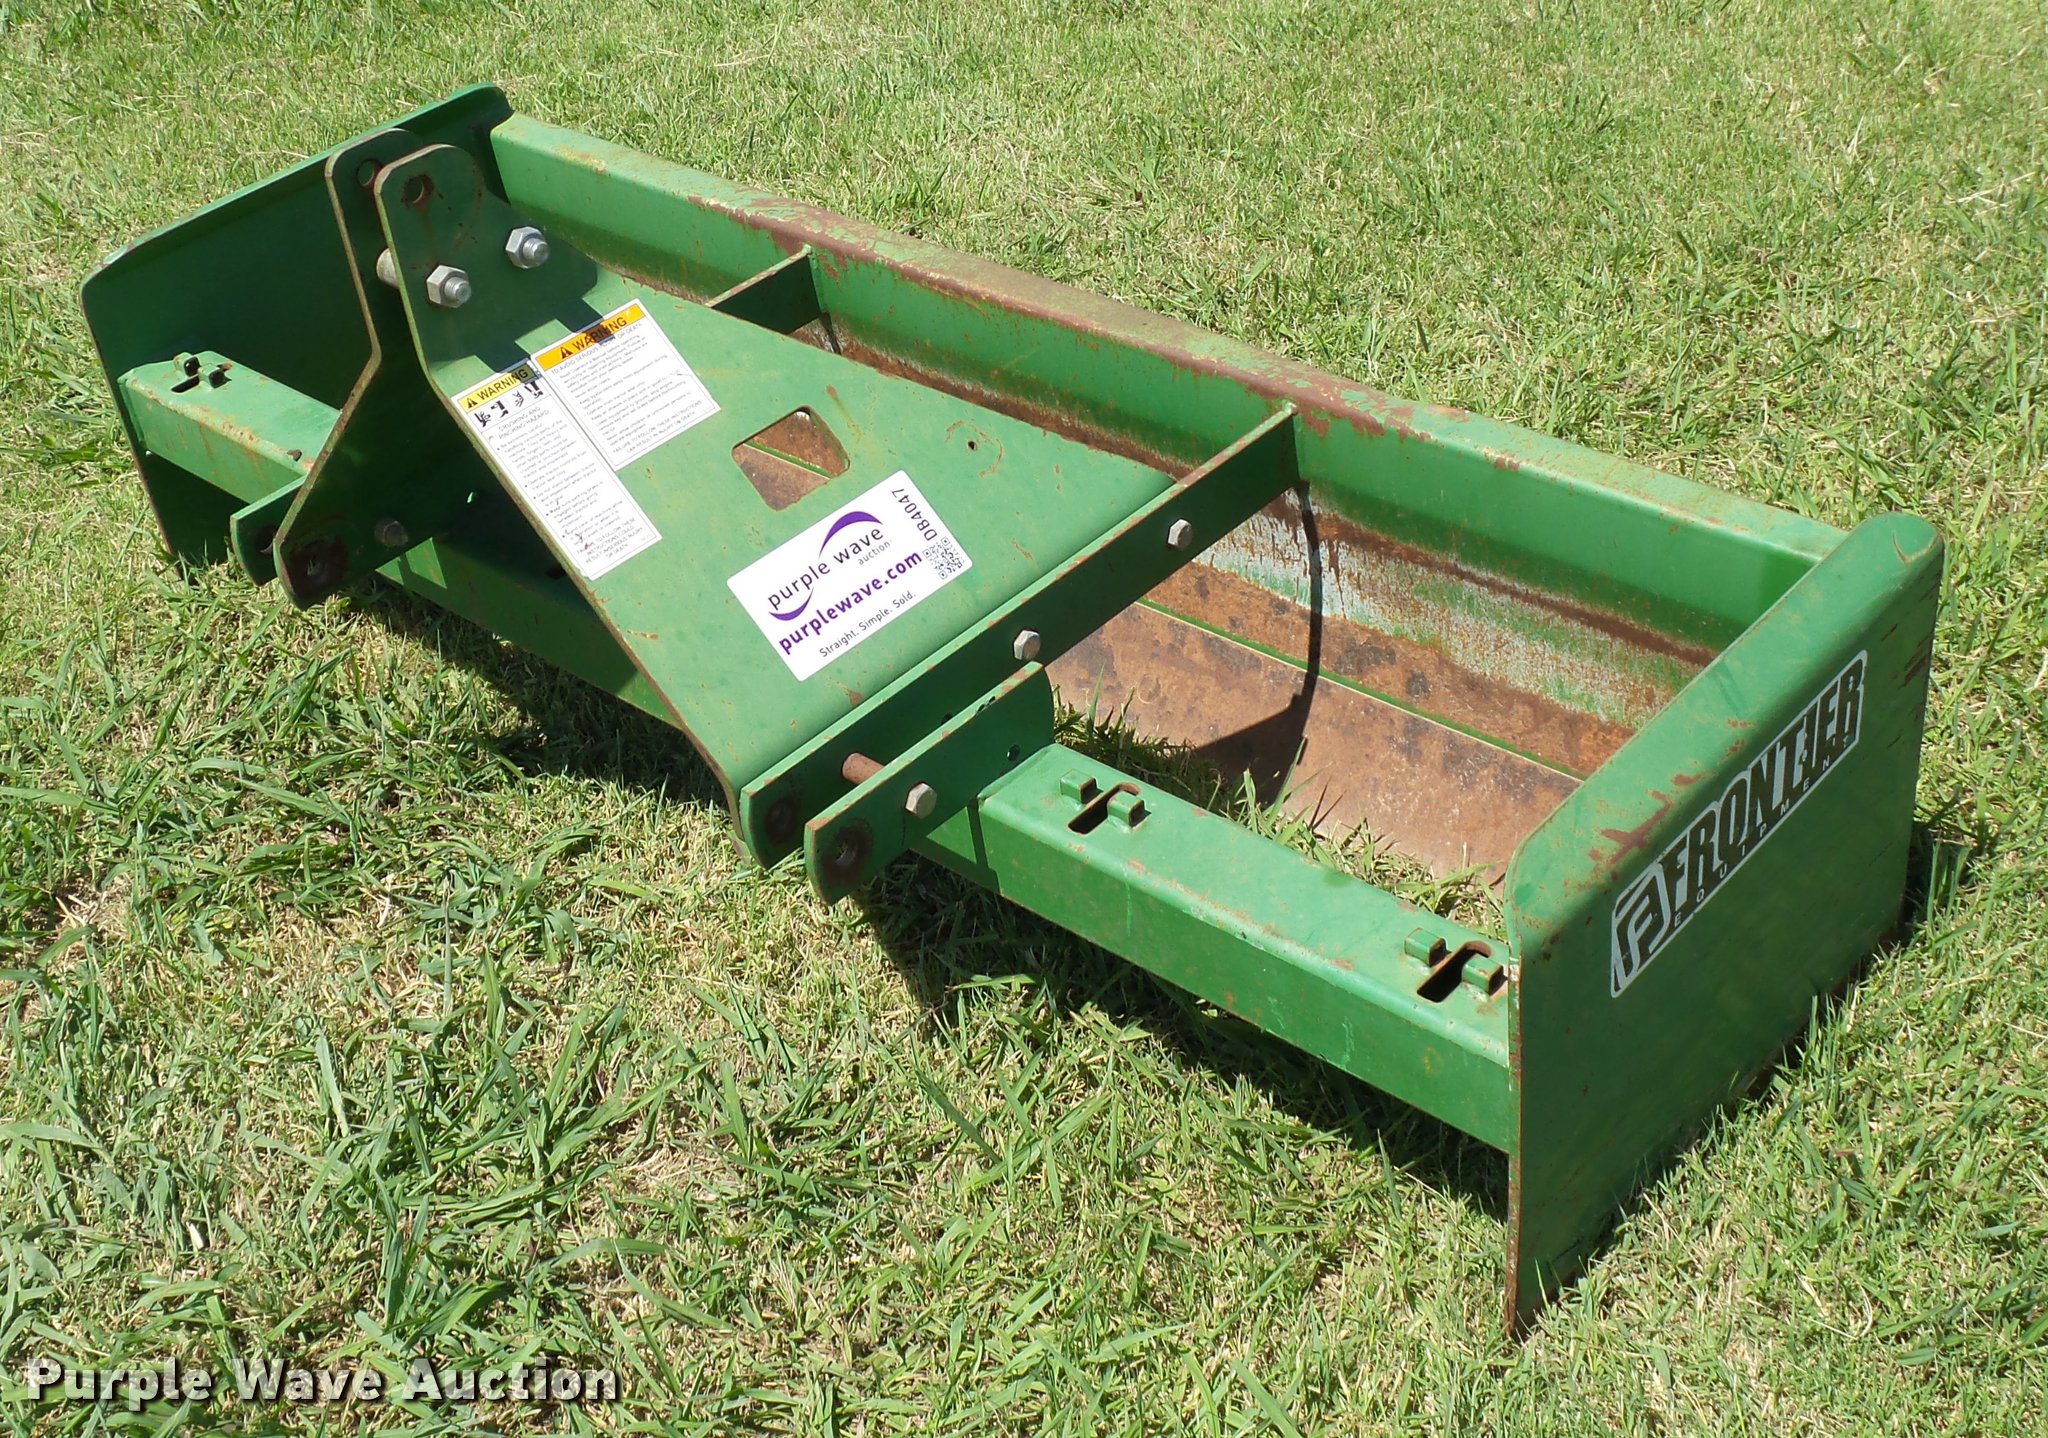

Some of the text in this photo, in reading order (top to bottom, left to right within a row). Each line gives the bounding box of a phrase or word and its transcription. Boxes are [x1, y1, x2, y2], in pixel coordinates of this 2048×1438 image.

[570, 315, 628, 351] WARNING
[474, 367, 531, 402] WARNING
[892, 488, 938, 541] DB4047
[767, 527, 884, 610] purple wave
[857, 540, 891, 566] auction
[778, 550, 923, 656] purplewave.com
[819, 591, 917, 658] Straight. Simple. Sold.
[1659, 658, 1864, 910] FRONTIER
